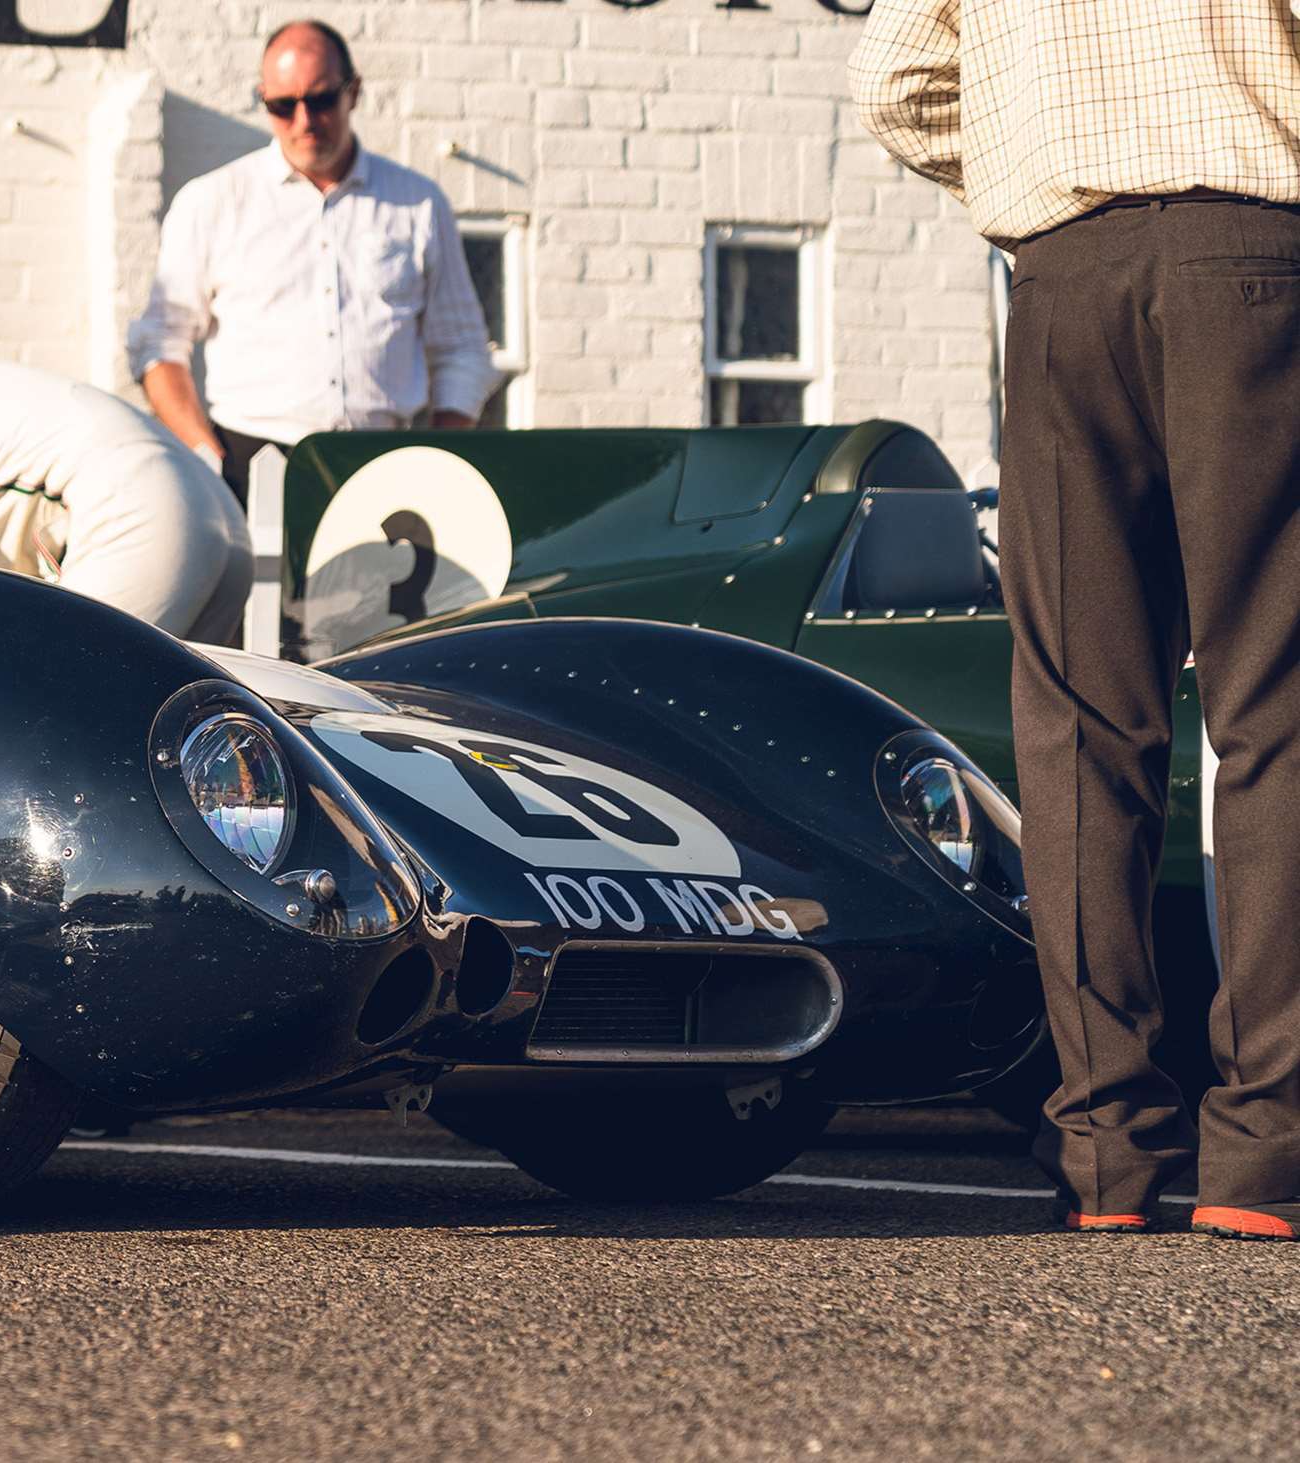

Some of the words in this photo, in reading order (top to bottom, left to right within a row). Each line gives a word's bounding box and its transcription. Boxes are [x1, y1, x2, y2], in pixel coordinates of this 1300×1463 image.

[360, 731, 680, 847] 26
[523, 873, 645, 933] 100
[645, 878, 803, 941] MDG
